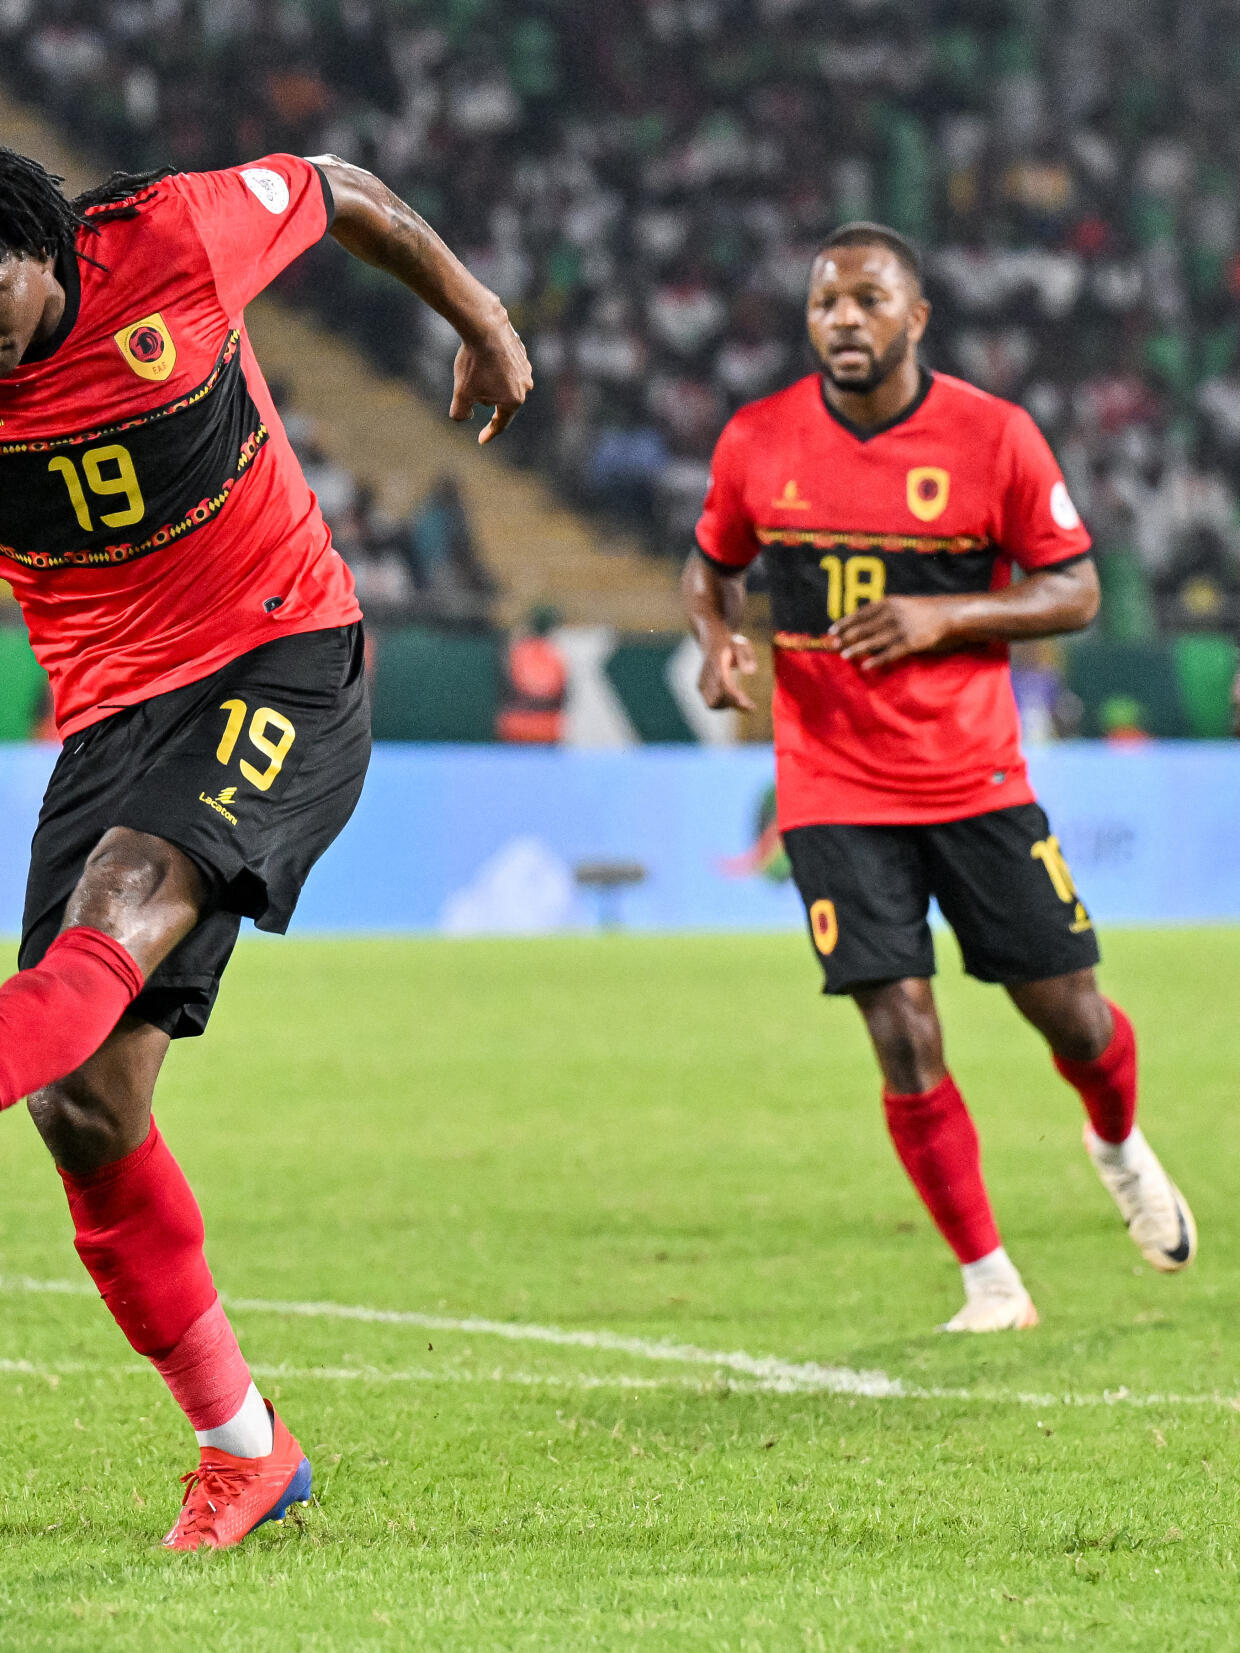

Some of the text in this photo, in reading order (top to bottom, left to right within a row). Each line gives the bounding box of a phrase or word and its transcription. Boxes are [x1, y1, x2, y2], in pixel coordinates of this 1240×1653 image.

[48, 444, 145, 532] 19
[820, 555, 887, 622] 18
[216, 699, 296, 791] 19
[198, 791, 238, 826] Lacatoni
